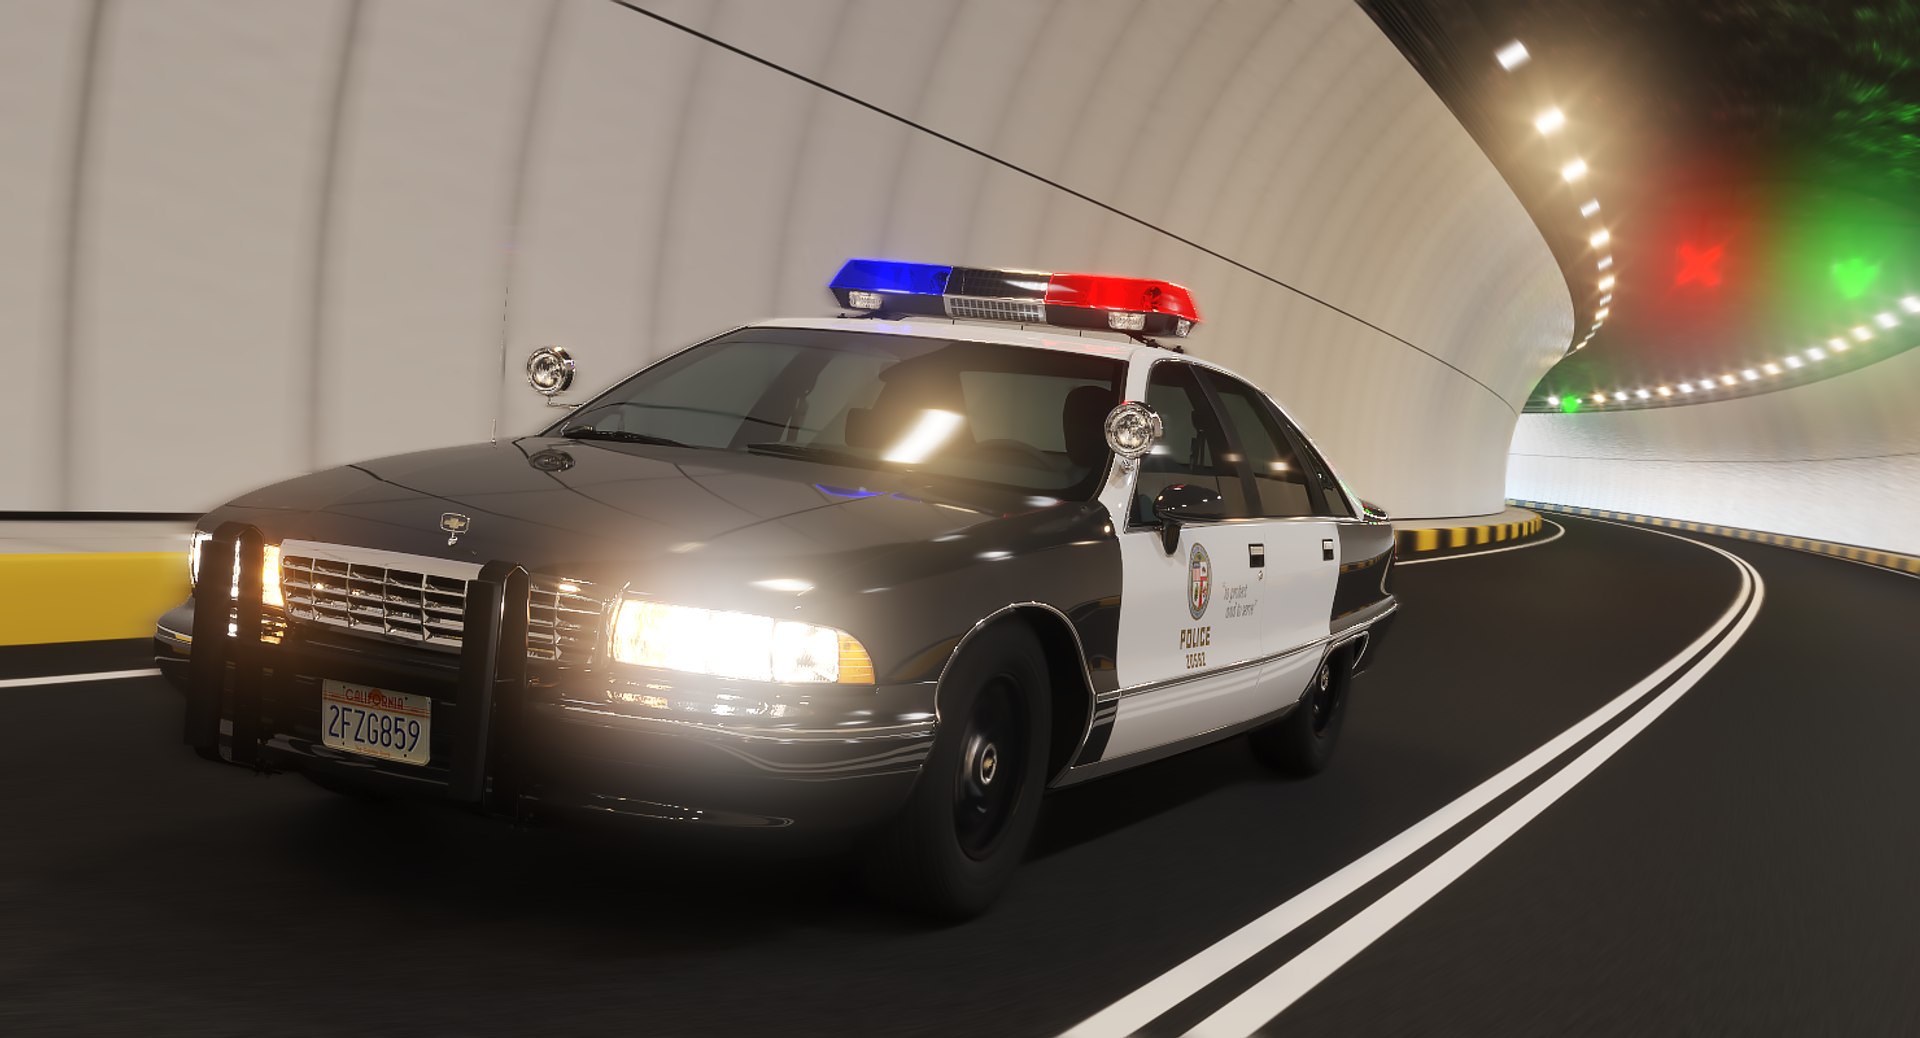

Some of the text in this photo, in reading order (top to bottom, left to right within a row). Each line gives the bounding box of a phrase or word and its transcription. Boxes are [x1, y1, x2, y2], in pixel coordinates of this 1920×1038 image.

[1180, 626, 1211, 650] POLICE
[345, 688, 404, 710] CALIFORNIA
[329, 704, 420, 752] 2FZG859
